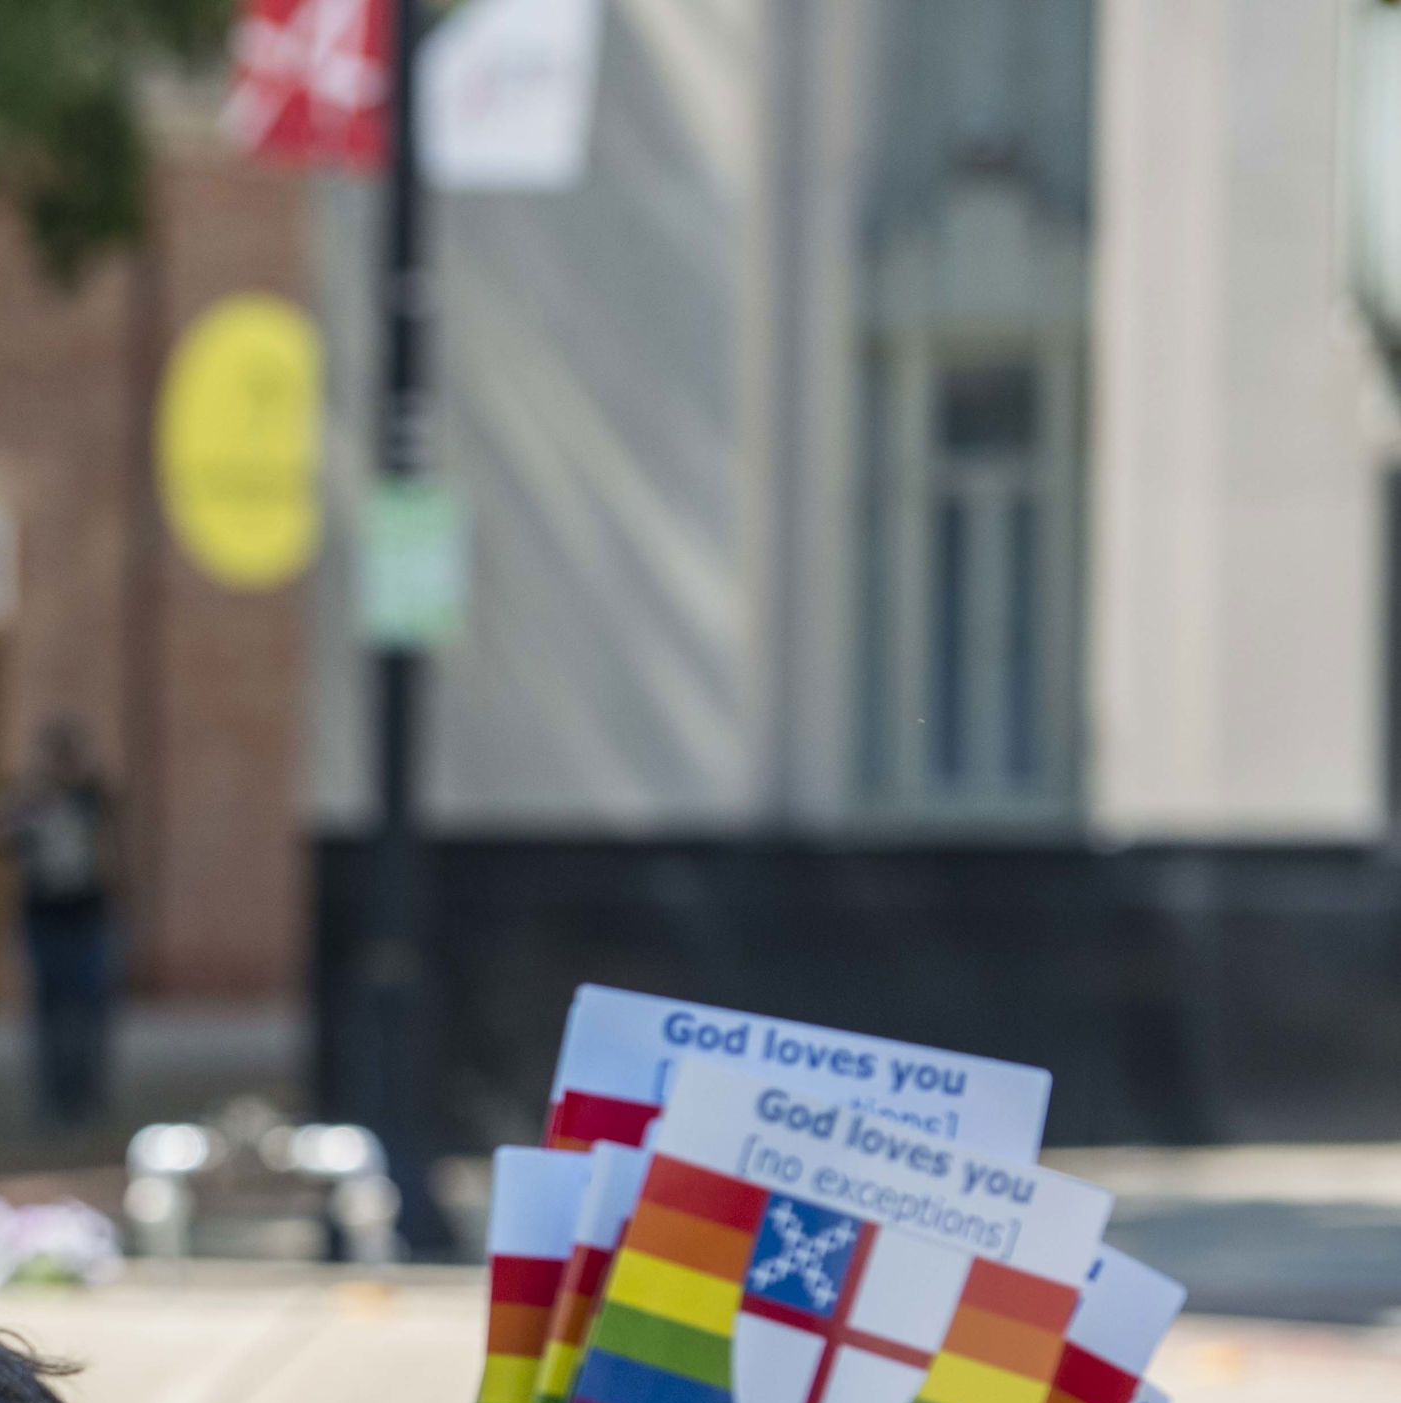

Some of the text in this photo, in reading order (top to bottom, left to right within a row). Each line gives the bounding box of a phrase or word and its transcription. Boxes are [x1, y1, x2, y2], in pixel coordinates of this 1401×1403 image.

[663, 1011, 967, 1096] God loves you
[737, 1133, 1022, 1259] [no exceptions]
[755, 1088, 839, 1140] God
[847, 1116, 953, 1178] loves
[962, 1160, 1037, 1206] you
